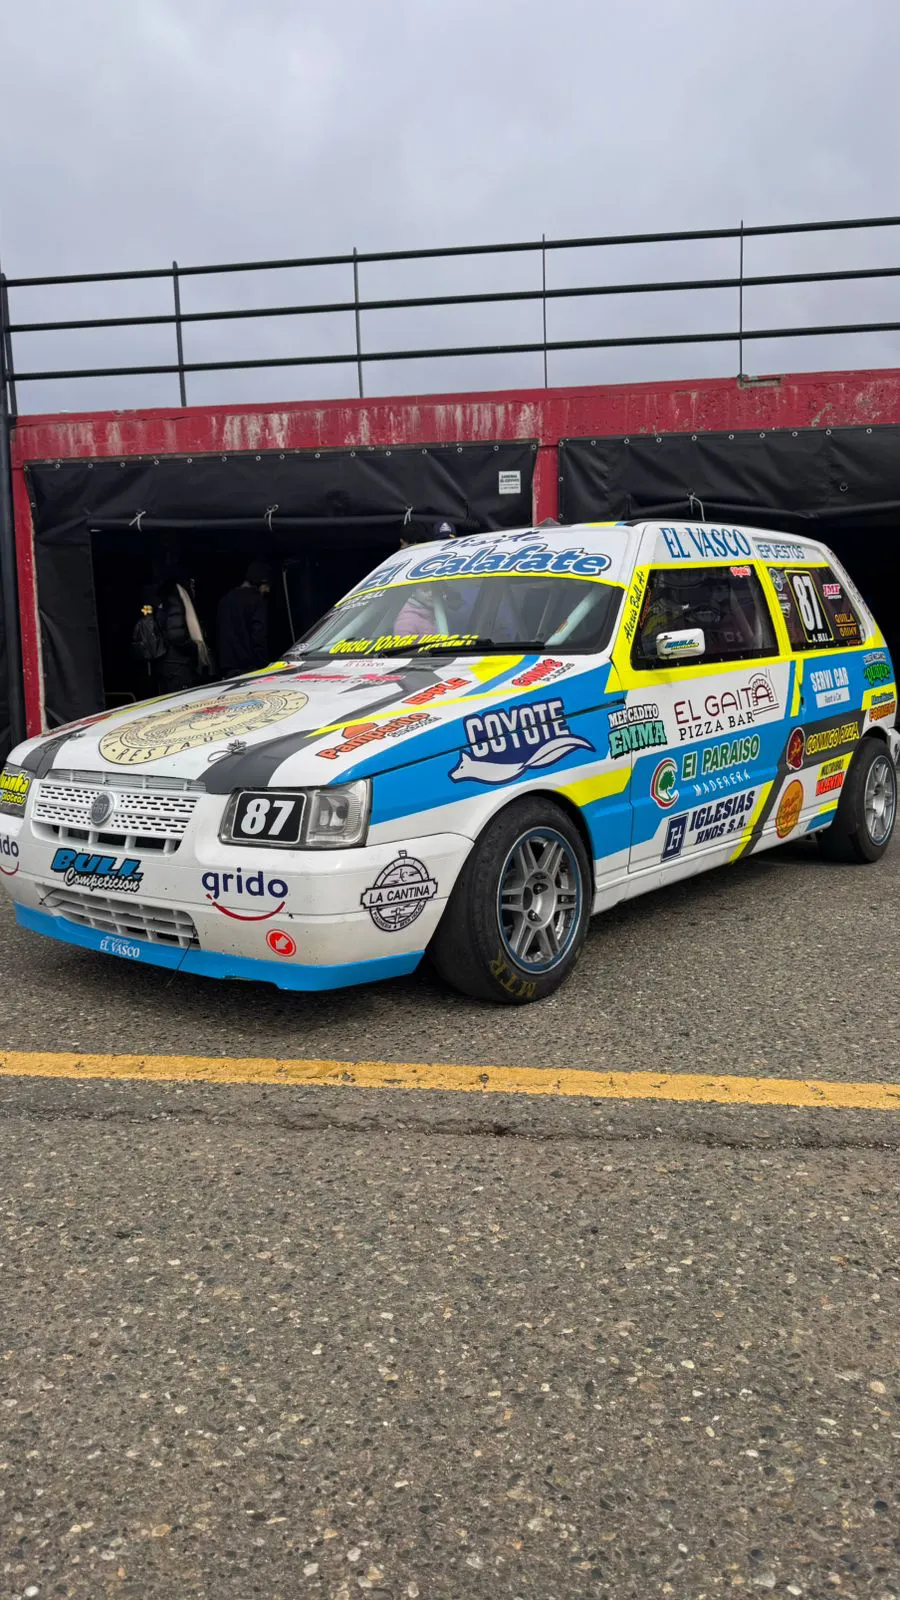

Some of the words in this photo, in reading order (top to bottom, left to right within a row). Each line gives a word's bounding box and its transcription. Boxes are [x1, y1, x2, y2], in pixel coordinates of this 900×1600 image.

[441, 529, 545, 551] Visite
[659, 528, 691, 559] EL
[685, 528, 752, 558] VASCO
[359, 559, 413, 590] El
[406, 543, 612, 581] Calafate
[629, 584, 643, 609] Bull
[792, 575, 823, 631] 87
[624, 609, 640, 643] Alexis
[363, 635, 418, 656] JORGE
[810, 669, 834, 693] SERVI
[833, 666, 849, 687] CAR
[607, 703, 659, 729] MERCADITO
[673, 699, 702, 725] EL
[704, 683, 773, 717] GAITA
[464, 699, 570, 758] COYOTE
[608, 720, 668, 758] EMMA
[678, 720, 724, 741] PIZZA
[728, 711, 755, 728] BAR
[839, 721, 860, 744] PIZZA
[701, 733, 760, 775] PARAISO
[692, 769, 751, 796] MADERERA
[239, 797, 296, 836] 87
[689, 790, 755, 832] IGLESIAS
[694, 822, 726, 845] HNOS
[727, 815, 747, 834] S.A.
[50, 847, 144, 881] BULL
[63, 867, 142, 893] Competición
[201, 867, 289, 900] grido
[369, 892, 383, 904] LA
[387, 885, 430, 902] CANTINA
[100, 939, 109, 951] EL
[111, 941, 140, 958] VASCO
